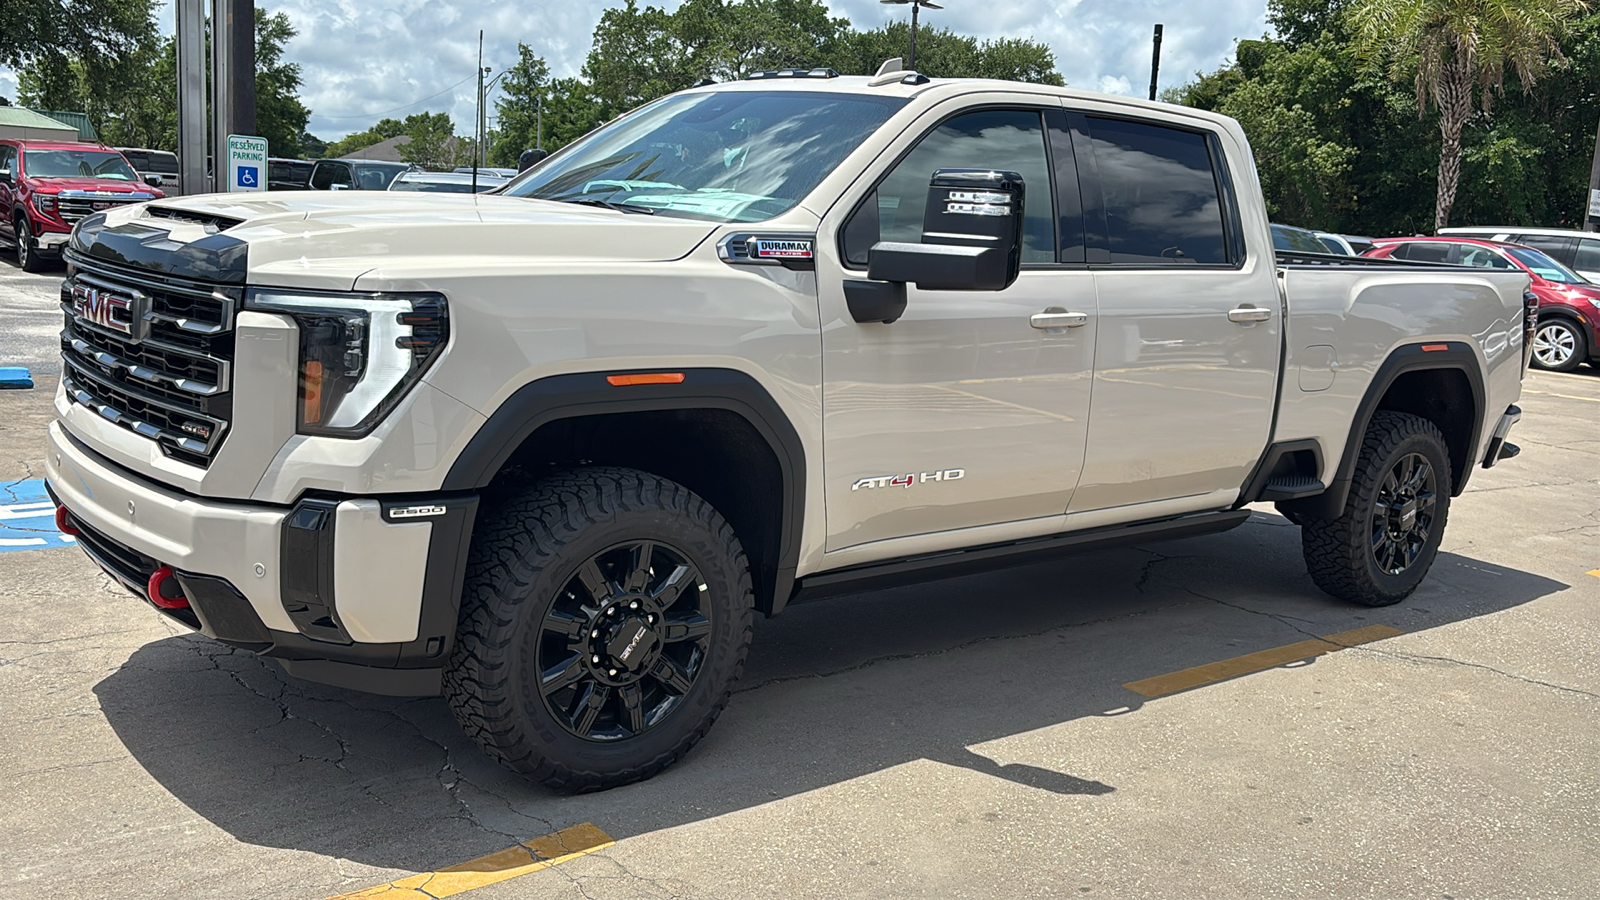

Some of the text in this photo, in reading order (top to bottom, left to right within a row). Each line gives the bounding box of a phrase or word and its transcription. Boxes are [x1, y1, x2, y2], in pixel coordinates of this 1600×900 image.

[230, 140, 265, 152] RESERVED
[232, 151, 263, 162] PARKING
[761, 241, 808, 251] DURAMAX
[72, 284, 133, 335] GMC
[851, 468, 966, 491] AT4 HD
[392, 506, 444, 516] 2500
[619, 625, 647, 662] GMC
